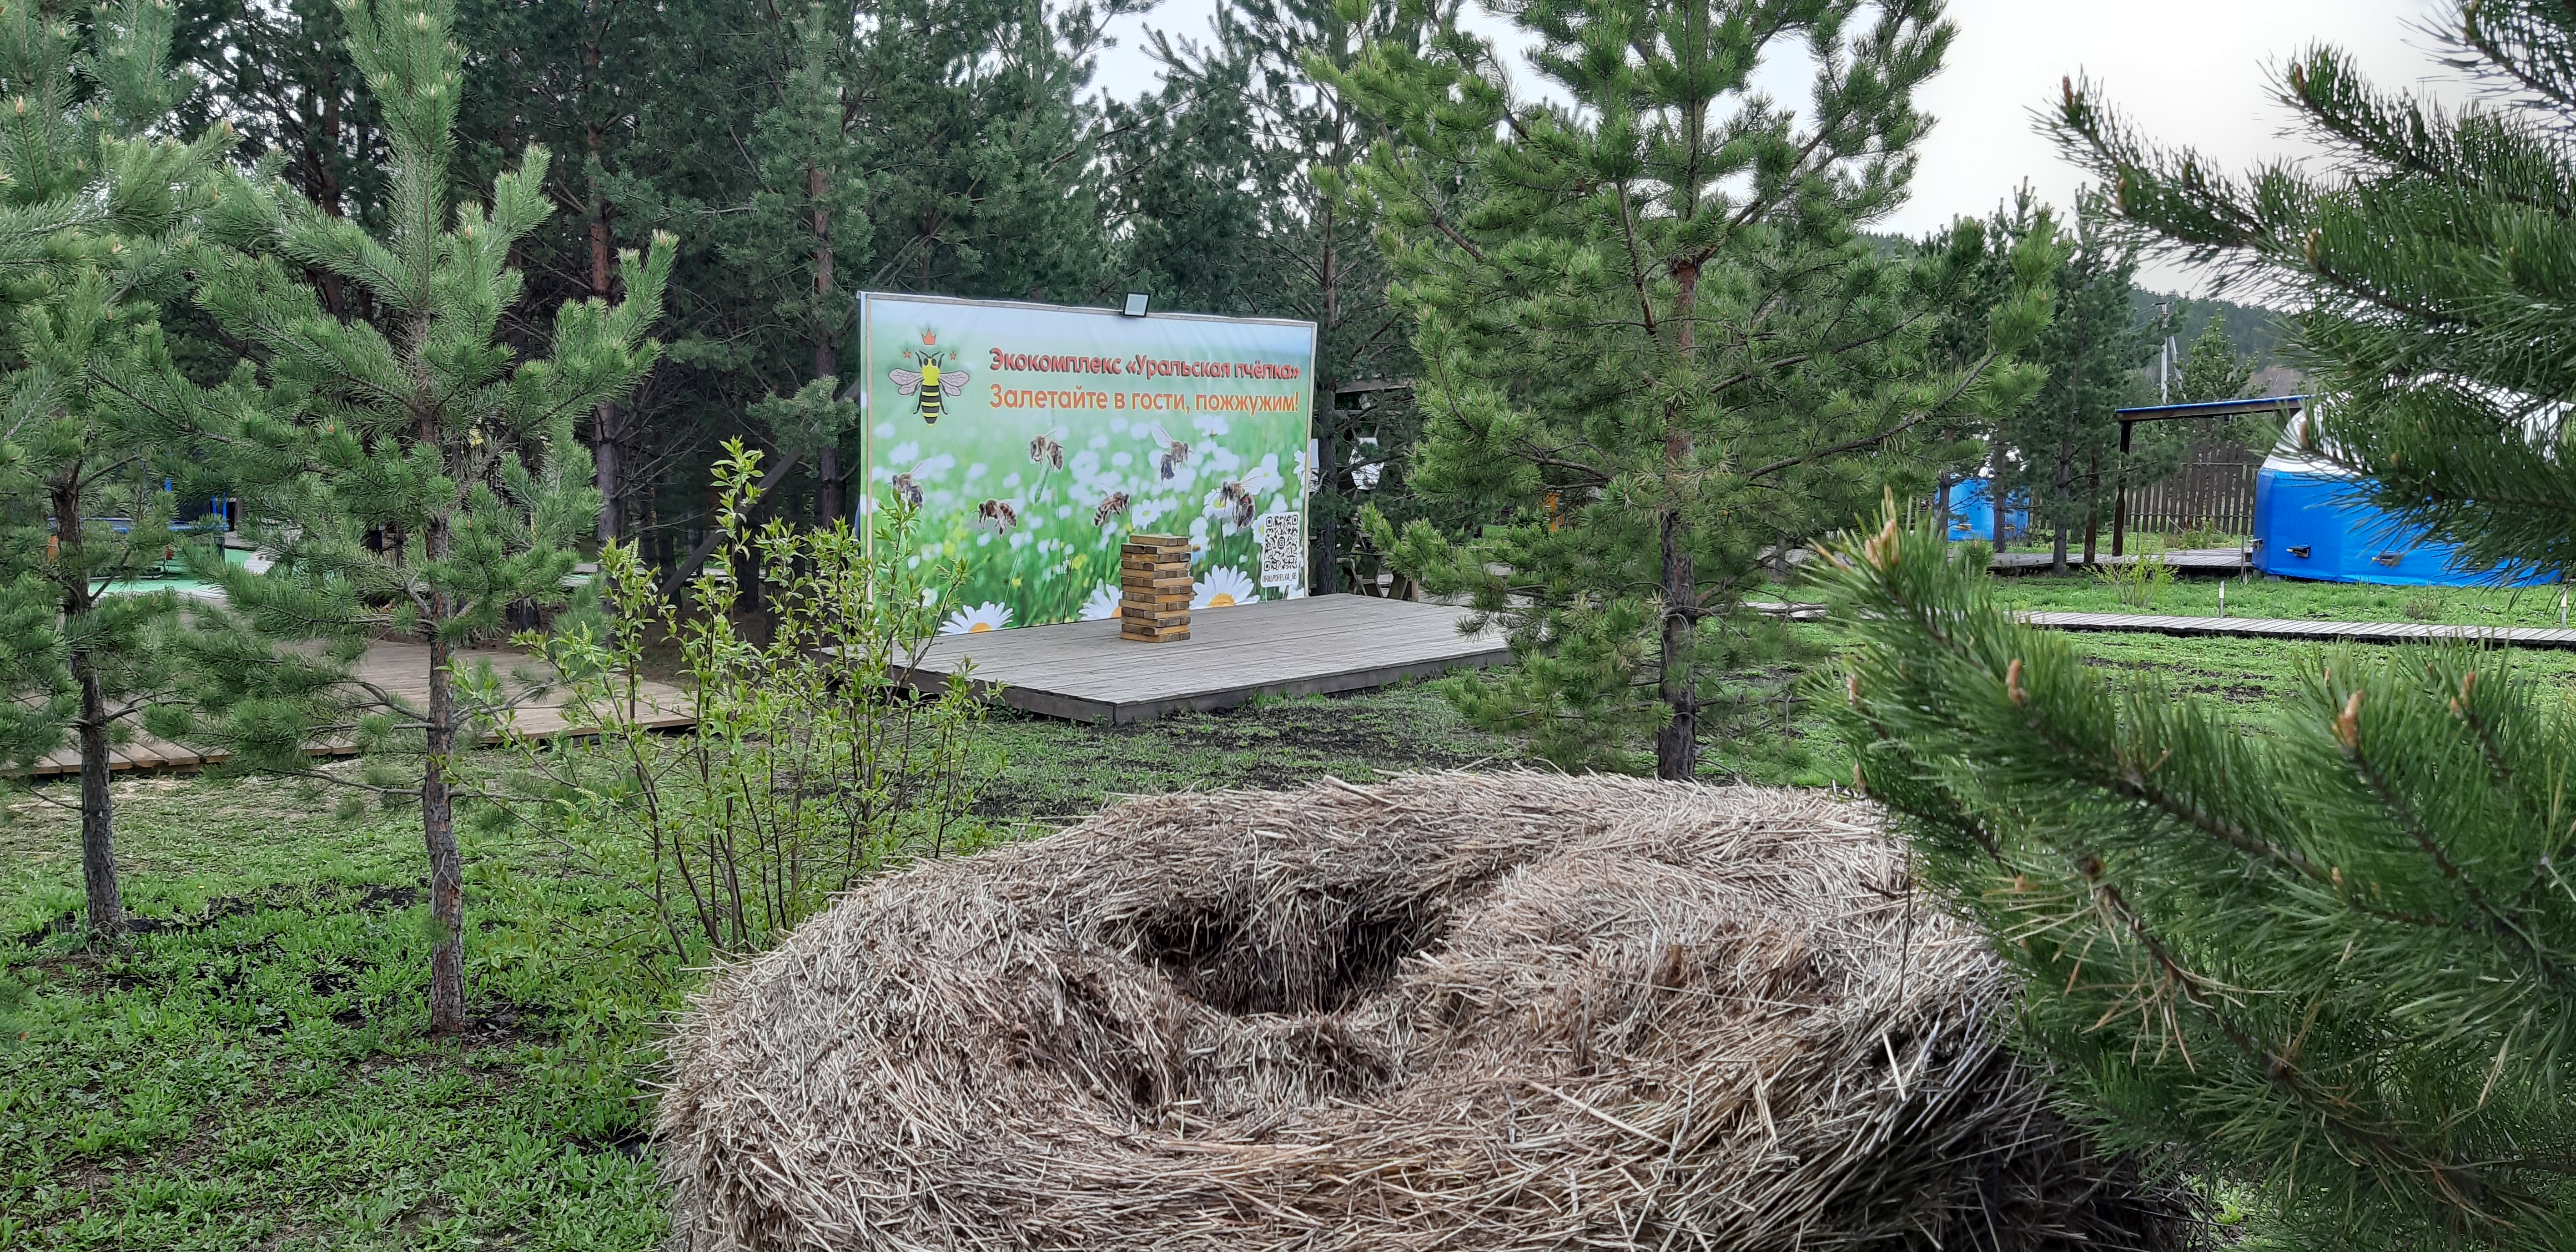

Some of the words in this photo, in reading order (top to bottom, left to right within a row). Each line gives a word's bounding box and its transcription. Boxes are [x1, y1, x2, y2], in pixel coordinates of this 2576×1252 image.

[989, 347, 1122, 375] Экокомплекс
[1126, 354, 1231, 380] «Уральская
[1234, 359, 1300, 379] пчёлка»
[990, 384, 1108, 409] Залетайте
[1114, 393, 1125, 409] в
[1132, 393, 1190, 414] гости,
[1196, 391, 1299, 416] пожжужим!
